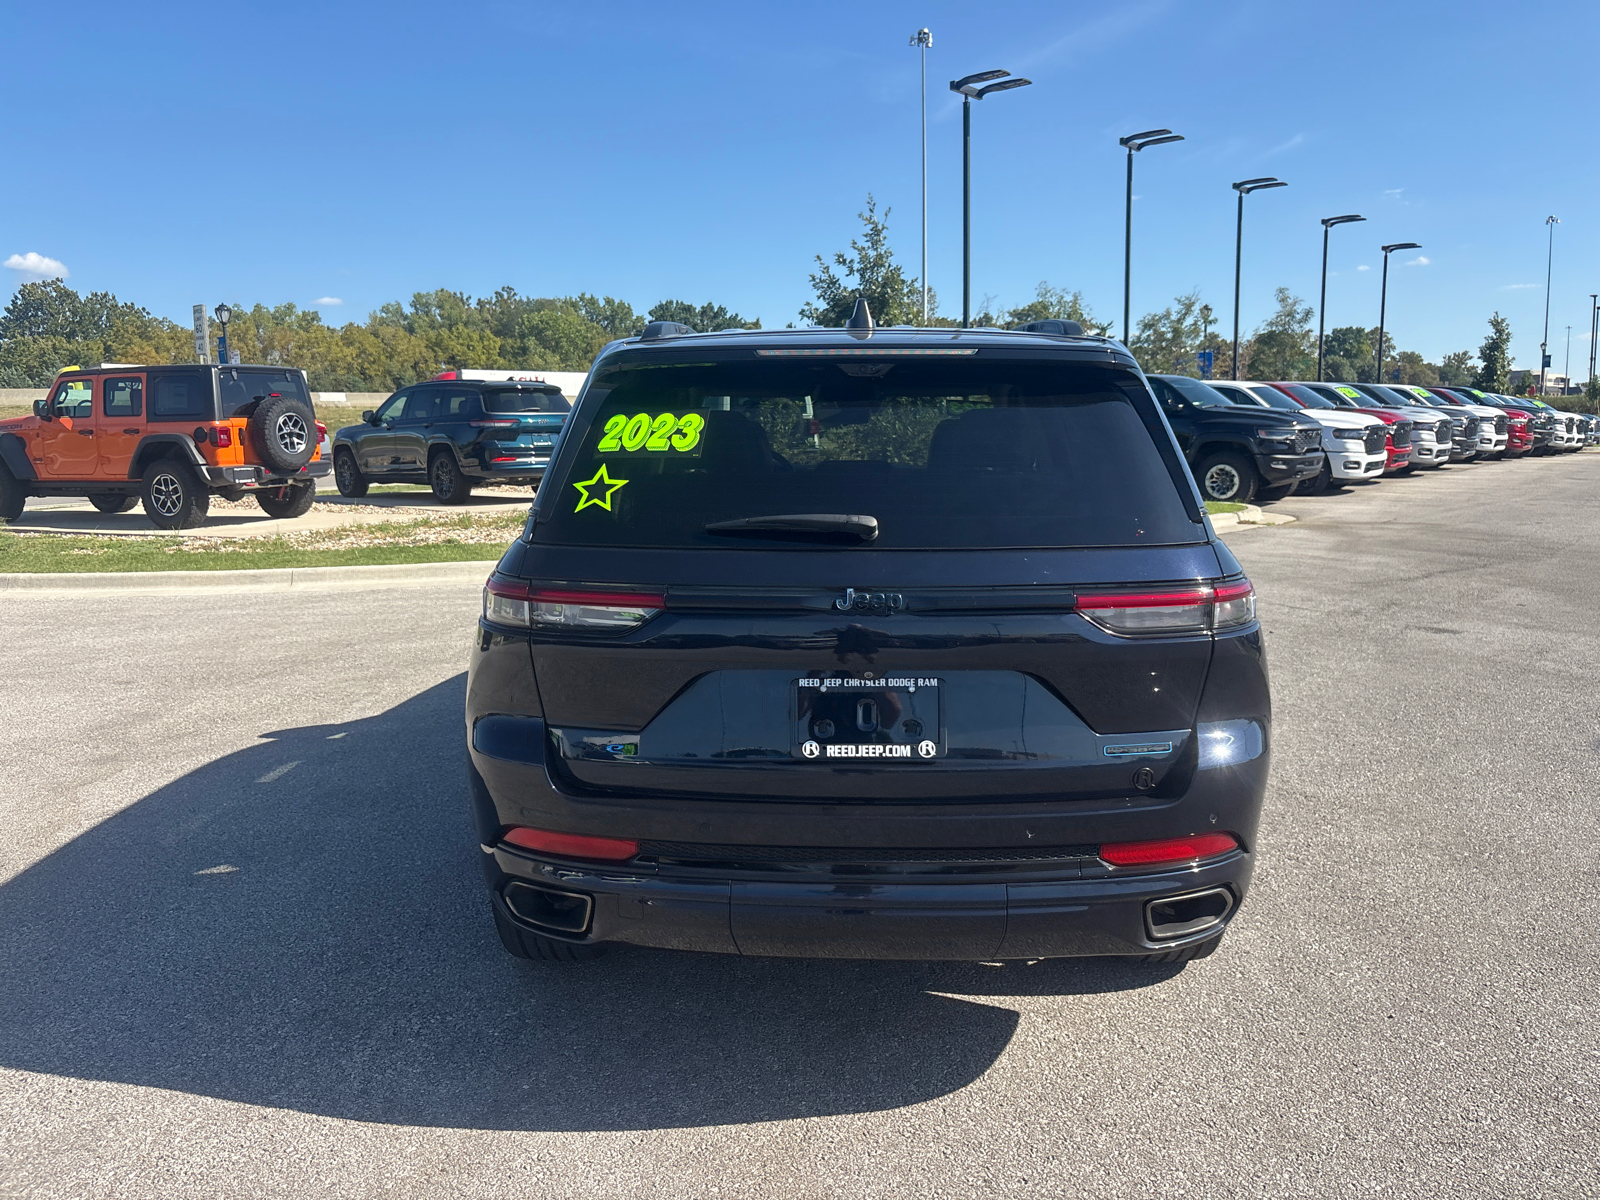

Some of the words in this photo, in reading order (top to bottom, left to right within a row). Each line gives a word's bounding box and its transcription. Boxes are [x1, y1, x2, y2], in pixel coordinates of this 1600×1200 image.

[598, 412, 705, 453] 2023
[836, 588, 903, 615] Jeep
[799, 678, 820, 687] REED
[822, 678, 842, 687] JEEP
[844, 678, 886, 687] CHRYSLER
[888, 678, 915, 687] DODGE
[917, 678, 938, 687] RAM
[827, 745, 911, 757] REEDJEEP.COM
